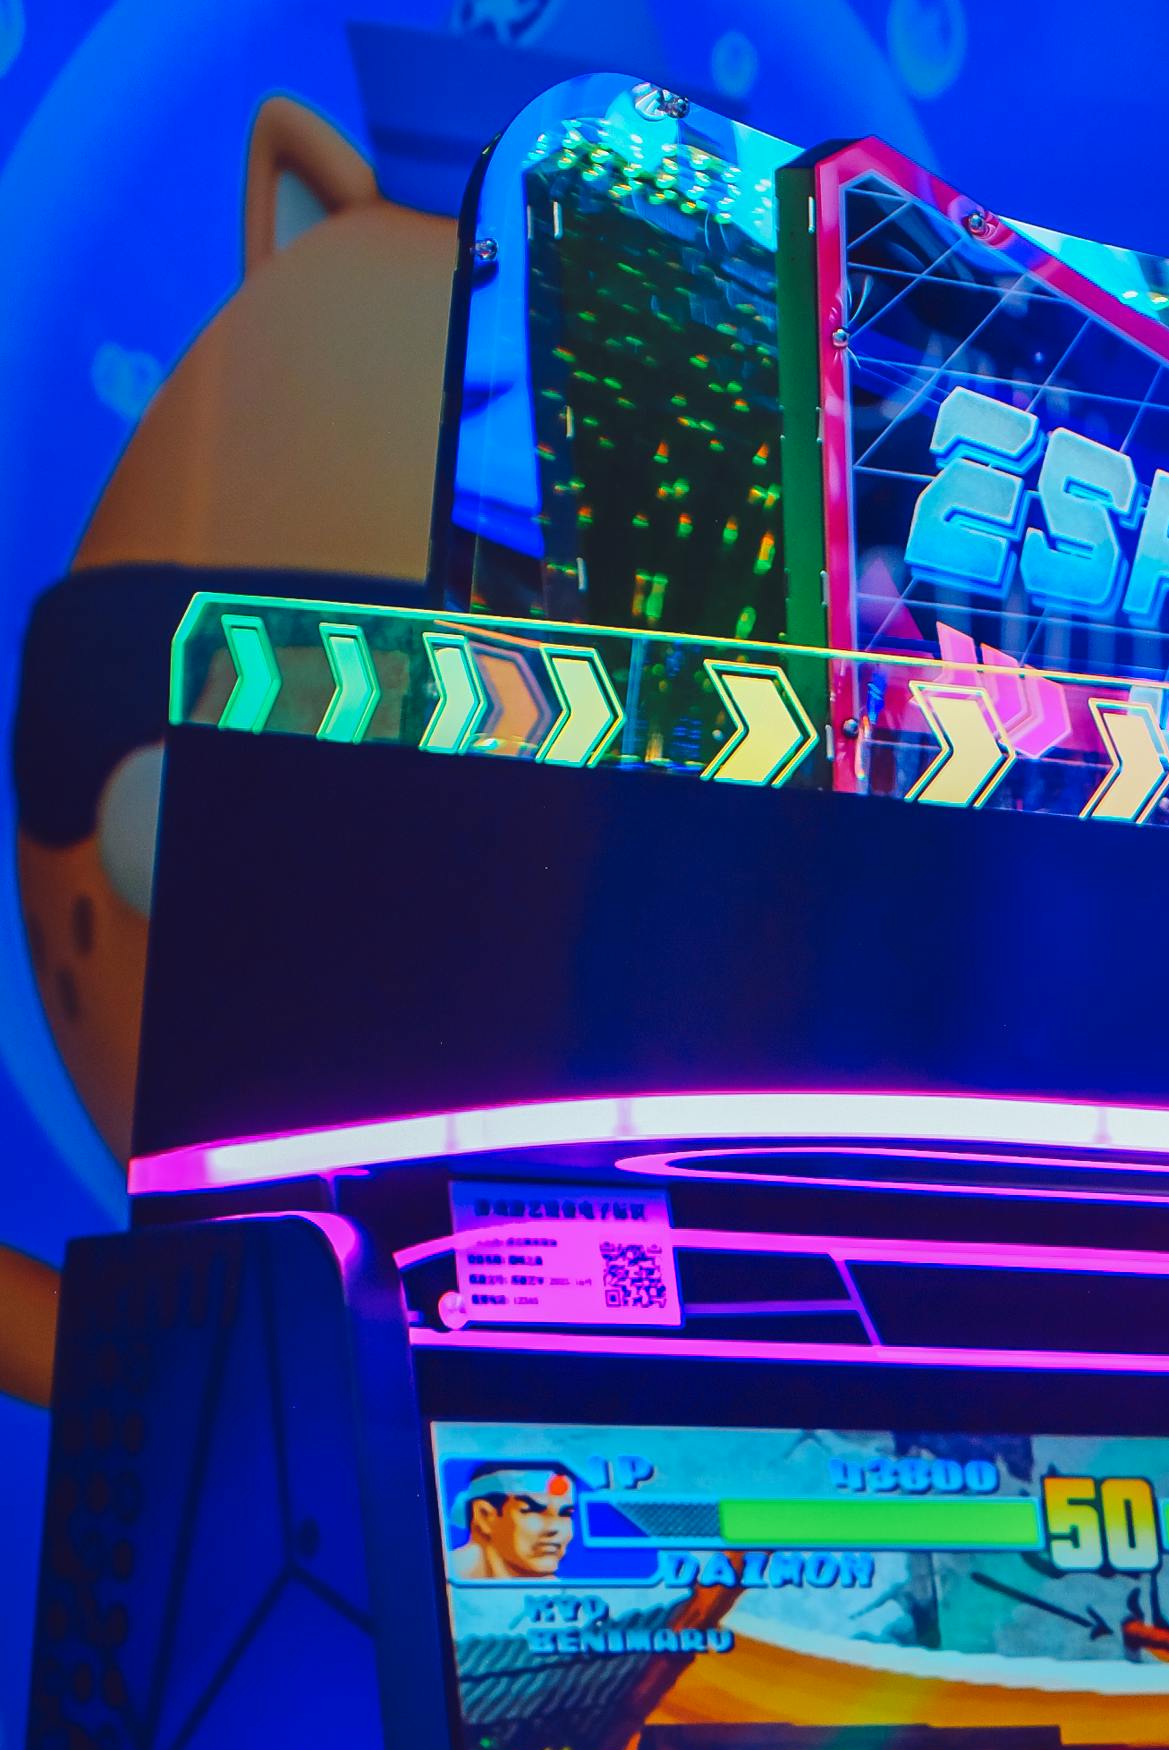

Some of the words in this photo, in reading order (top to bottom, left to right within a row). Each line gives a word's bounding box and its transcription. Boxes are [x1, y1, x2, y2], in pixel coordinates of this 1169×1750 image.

[1043, 1475, 1162, 1572] 50
[662, 1550, 876, 1590] DAIMON
[522, 1593, 611, 1623] KYO
[526, 1627, 736, 1655] BENIMARU
